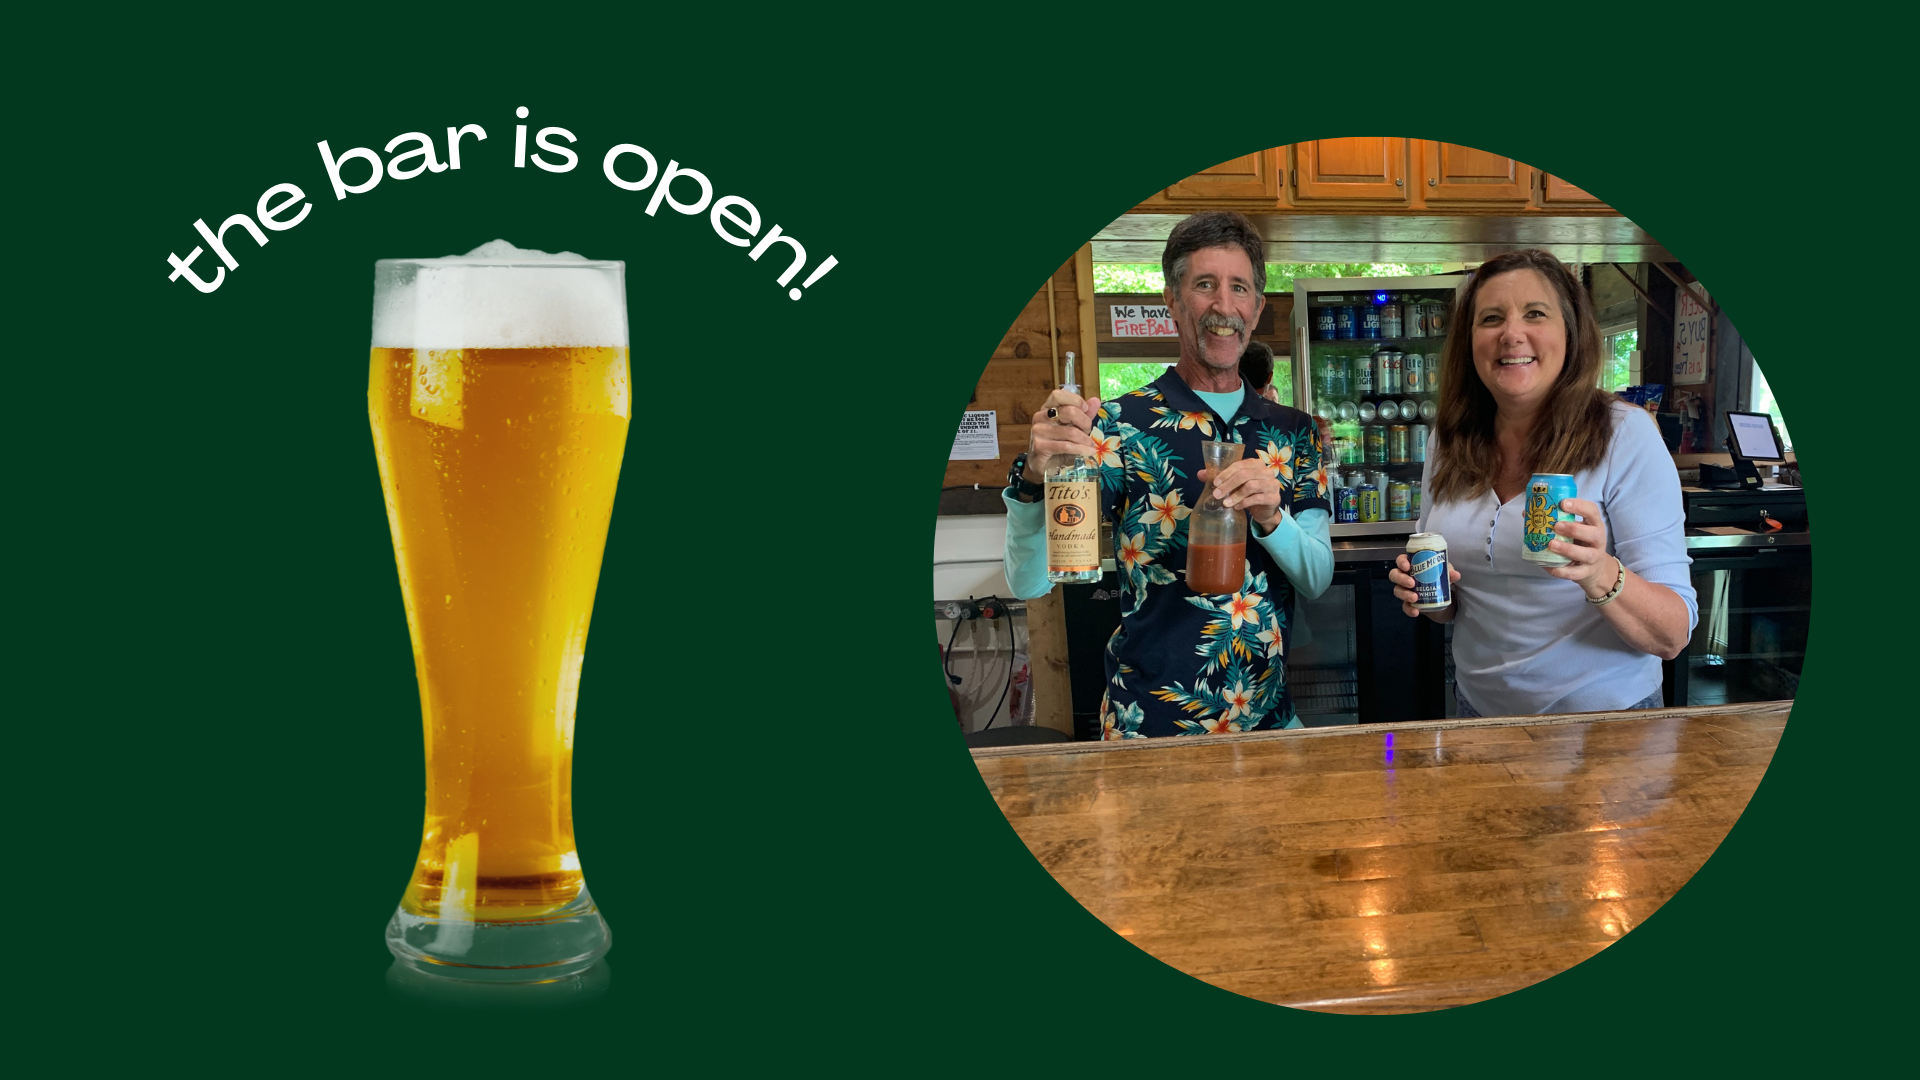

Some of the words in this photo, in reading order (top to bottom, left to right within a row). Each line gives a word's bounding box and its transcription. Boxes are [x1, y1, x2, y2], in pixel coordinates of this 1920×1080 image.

[1114, 305, 1136, 318] We
[1140, 305, 1171, 319] have
[1317, 322, 1336, 331] IGHT
[1363, 321, 1380, 329] LIGH
[1048, 484, 1091, 500] Tito's
[1048, 528, 1096, 541] Handmade
